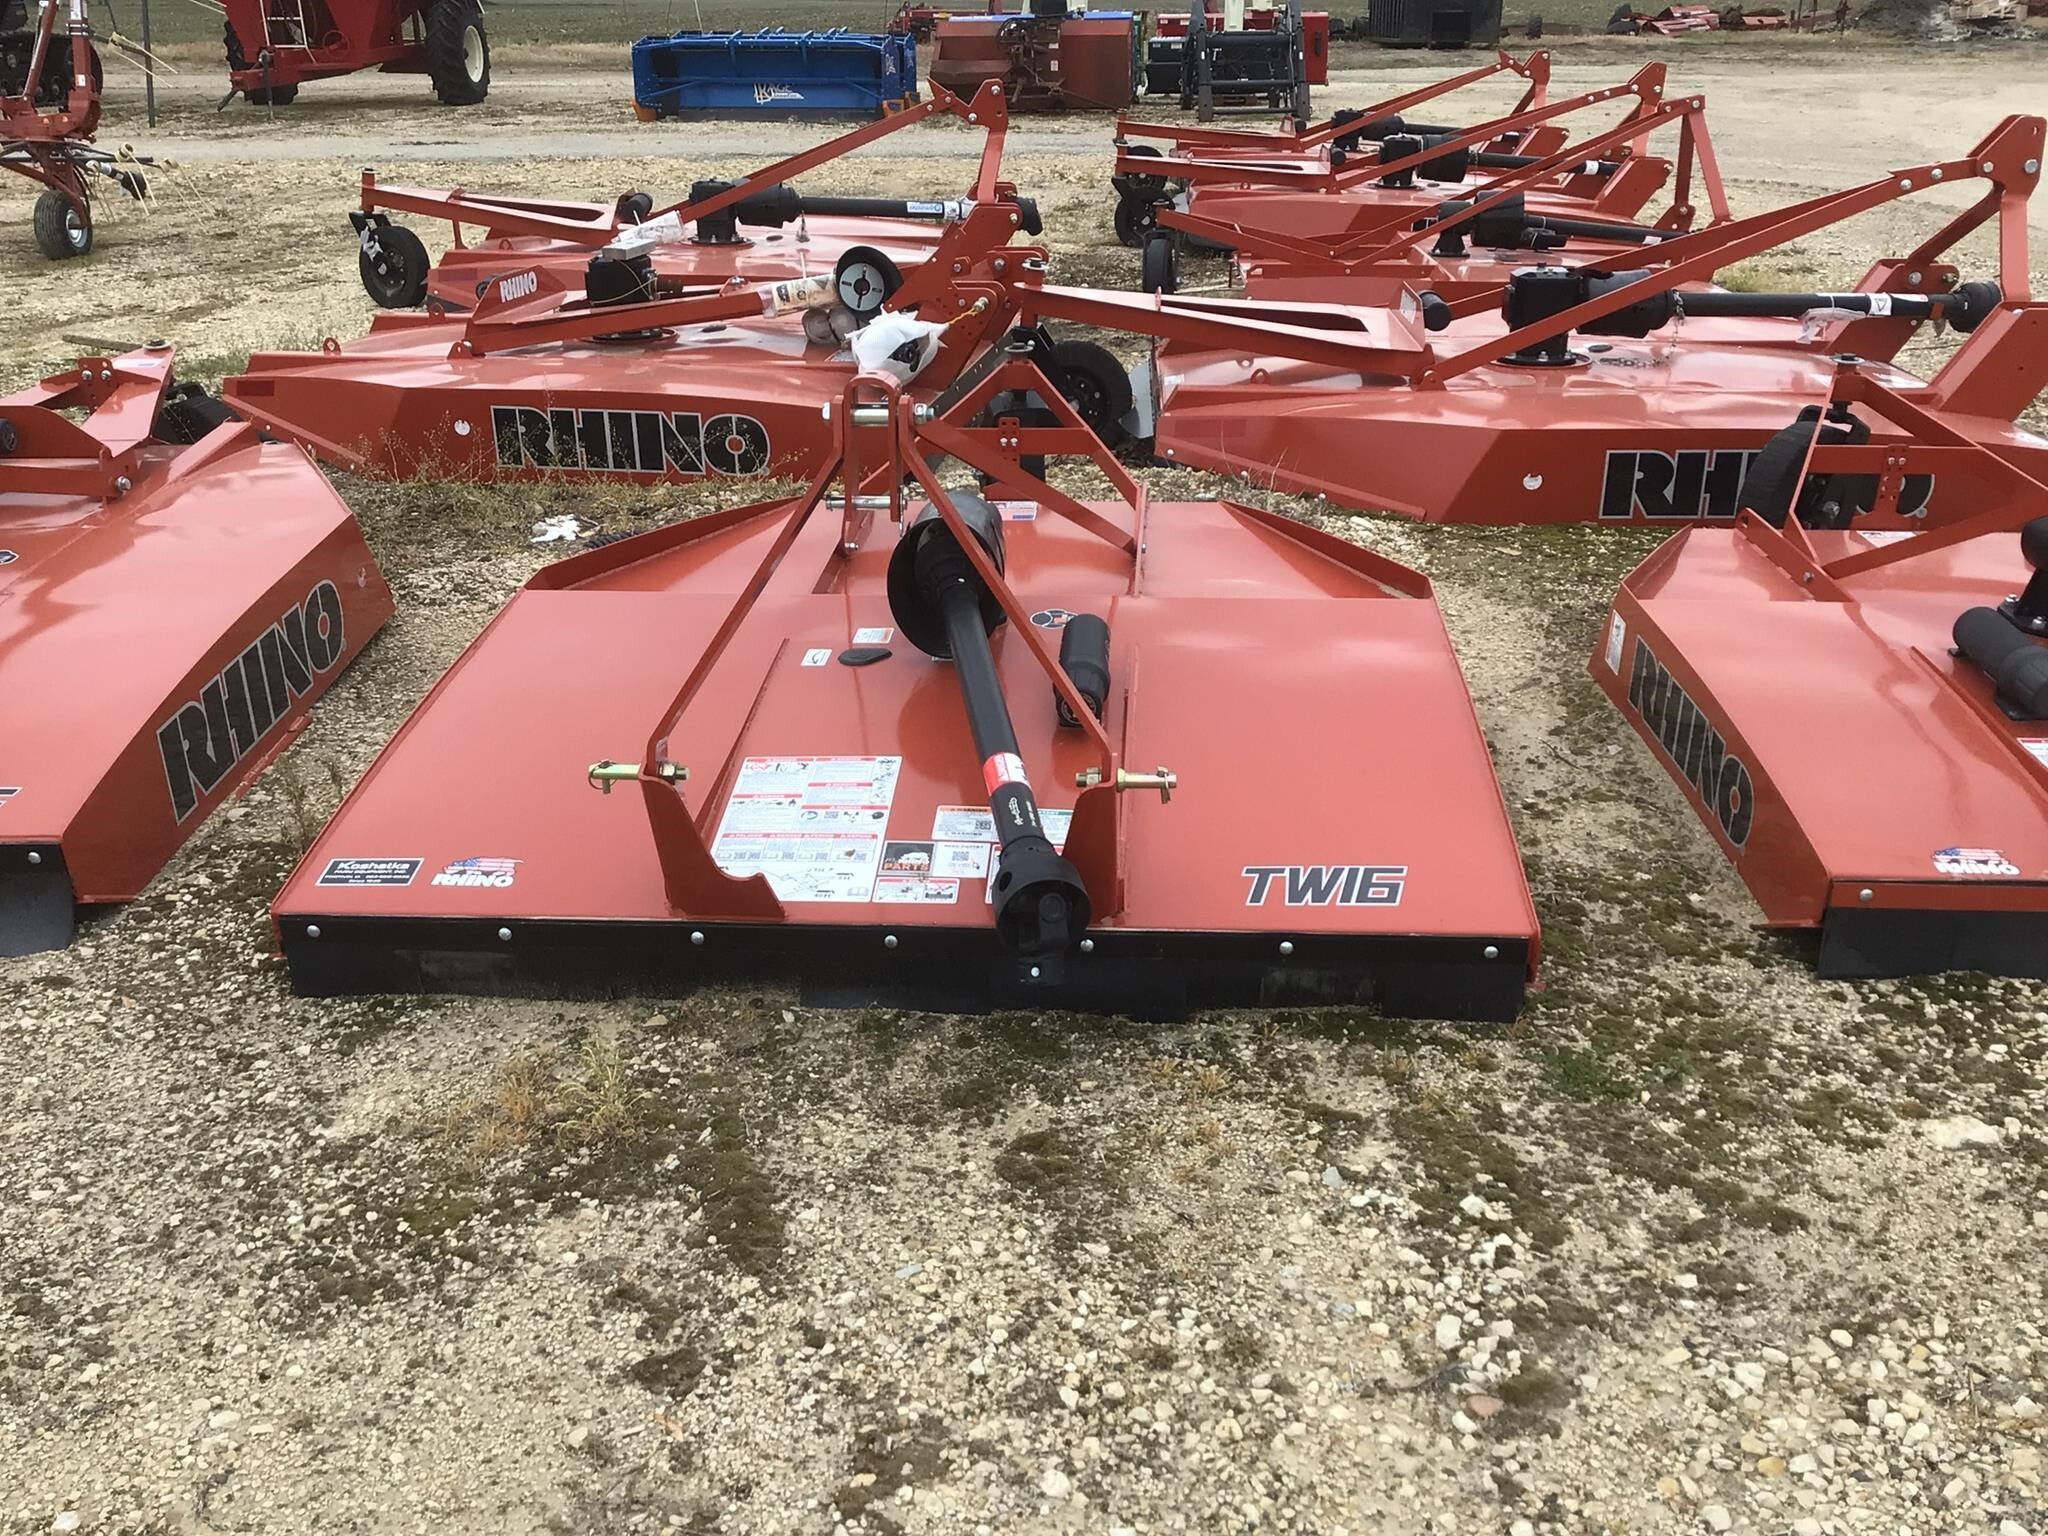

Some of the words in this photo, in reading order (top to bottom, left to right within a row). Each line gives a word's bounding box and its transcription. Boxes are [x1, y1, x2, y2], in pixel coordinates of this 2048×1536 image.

[500, 271, 537, 303] RHINO
[490, 405, 769, 476] RHINO
[156, 579, 346, 826] RHINO
[1628, 634, 1754, 848] RHINO
[431, 873, 514, 888] RHINO
[884, 863, 930, 871] PARTS
